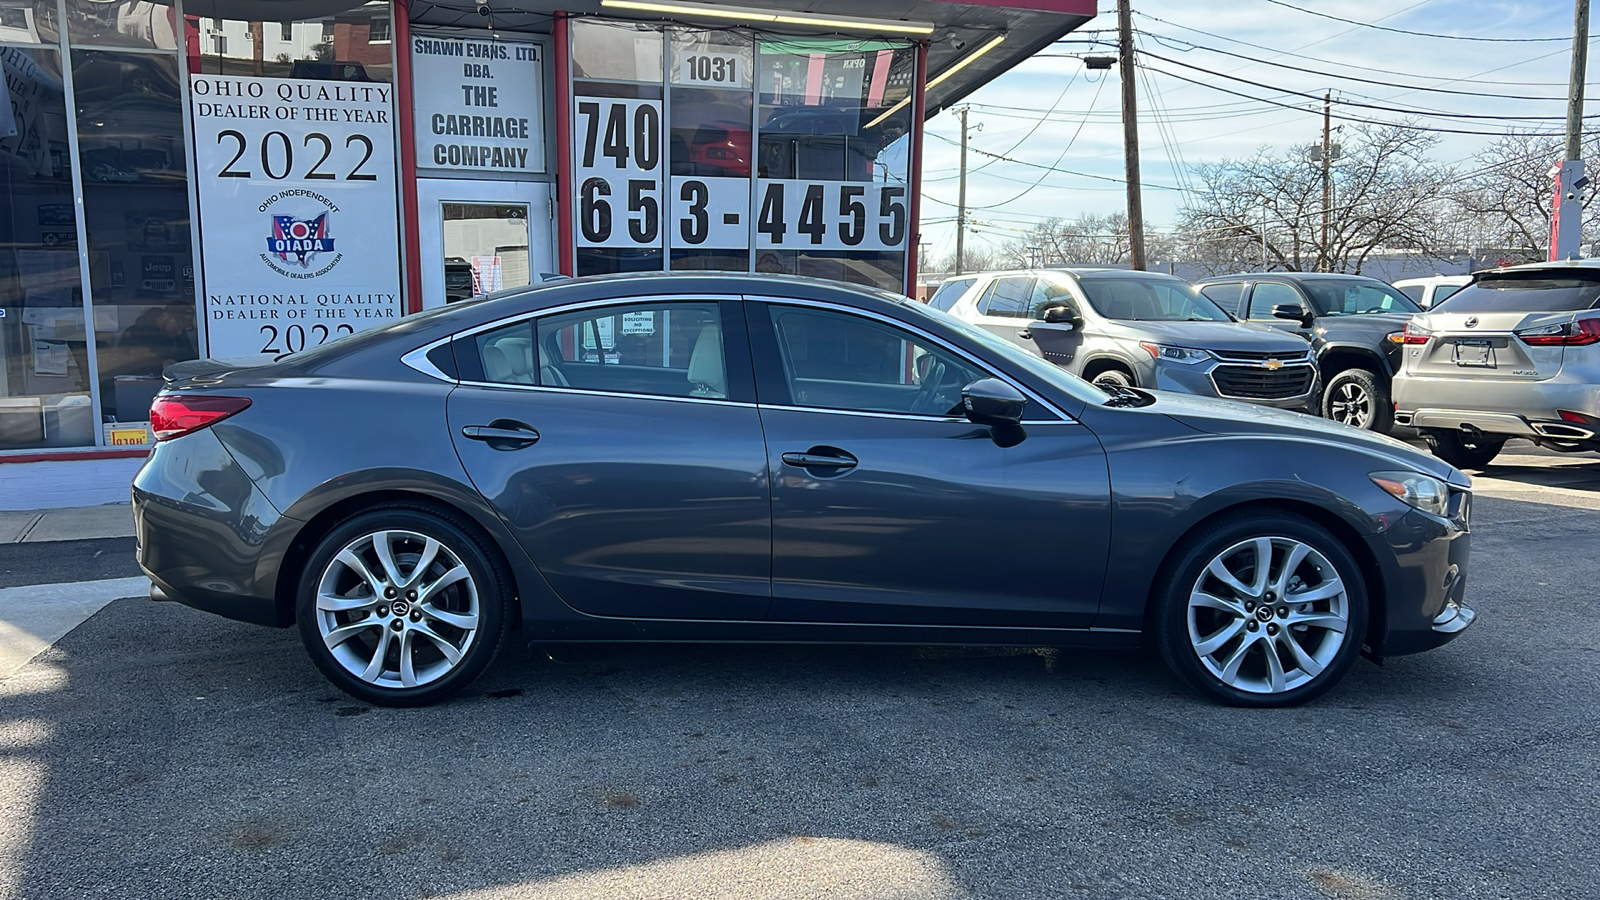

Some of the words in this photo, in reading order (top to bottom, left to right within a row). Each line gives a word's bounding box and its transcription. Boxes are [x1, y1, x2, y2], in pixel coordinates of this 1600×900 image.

[414, 39, 464, 57] SHAWN
[515, 47, 541, 62] LTD.
[463, 63, 494, 79] DBA.
[686, 55, 736, 83] 1031
[194, 79, 264, 97] OHIO
[277, 83, 390, 103] QUALITY
[461, 85, 498, 108] THE
[198, 103, 271, 119] DEALER
[275, 106, 298, 120] OF
[303, 107, 339, 122] THE
[342, 109, 389, 123] YEAR
[431, 113, 529, 139] CARRIAGE
[578, 102, 659, 172] 740
[217, 129, 377, 181] 2022
[433, 143, 529, 168] COMPANY
[258, 194, 279, 213] OHIO
[279, 189, 340, 213] INDEPENDENT
[275, 239, 324, 251] OIADA
[144, 262, 172, 273] Jeep
[260, 253, 289, 278] AUTOMOBILE
[290, 272, 315, 280] DEALERS
[315, 253, 343, 277] ASSOCIATION
[210, 294, 309, 306] NATIONAL
[316, 294, 396, 307] QUALITY
[213, 309, 279, 320] DEALER
[287, 308, 307, 319] OF
[314, 308, 346, 318] THE
[353, 308, 395, 318] YEAR
